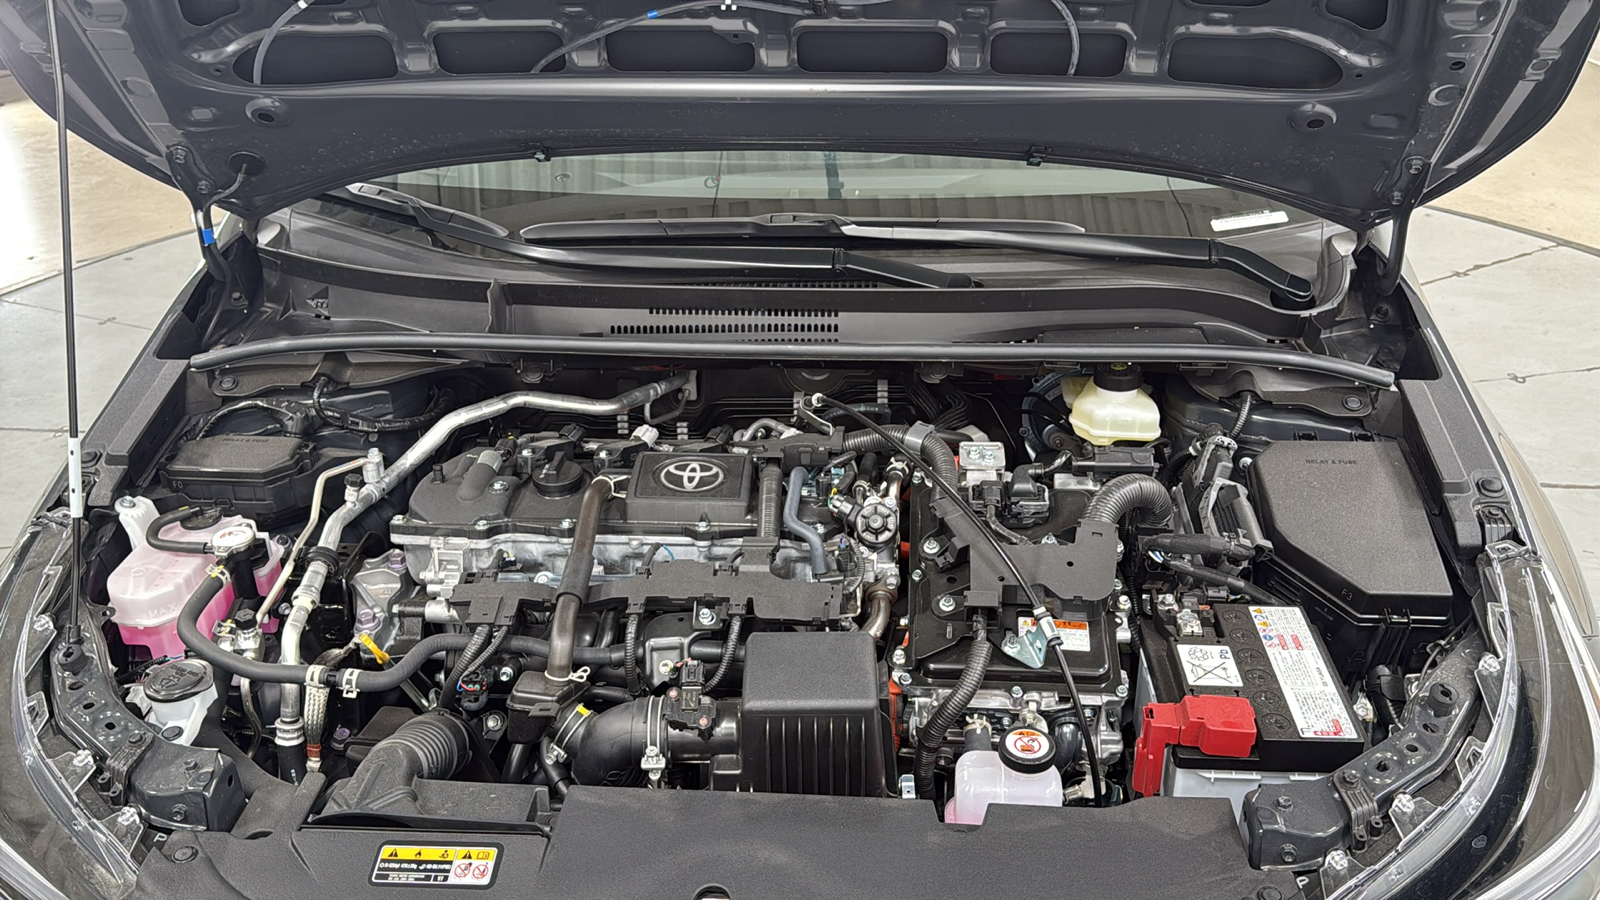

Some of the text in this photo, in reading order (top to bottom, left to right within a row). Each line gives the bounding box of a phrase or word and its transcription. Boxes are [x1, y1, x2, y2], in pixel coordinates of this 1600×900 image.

[1341, 588, 1354, 601] F3
[148, 602, 178, 620] MAX
[1219, 649, 1231, 660] Pb
[153, 832, 168, 843] P
[1296, 876, 1310, 889] P
